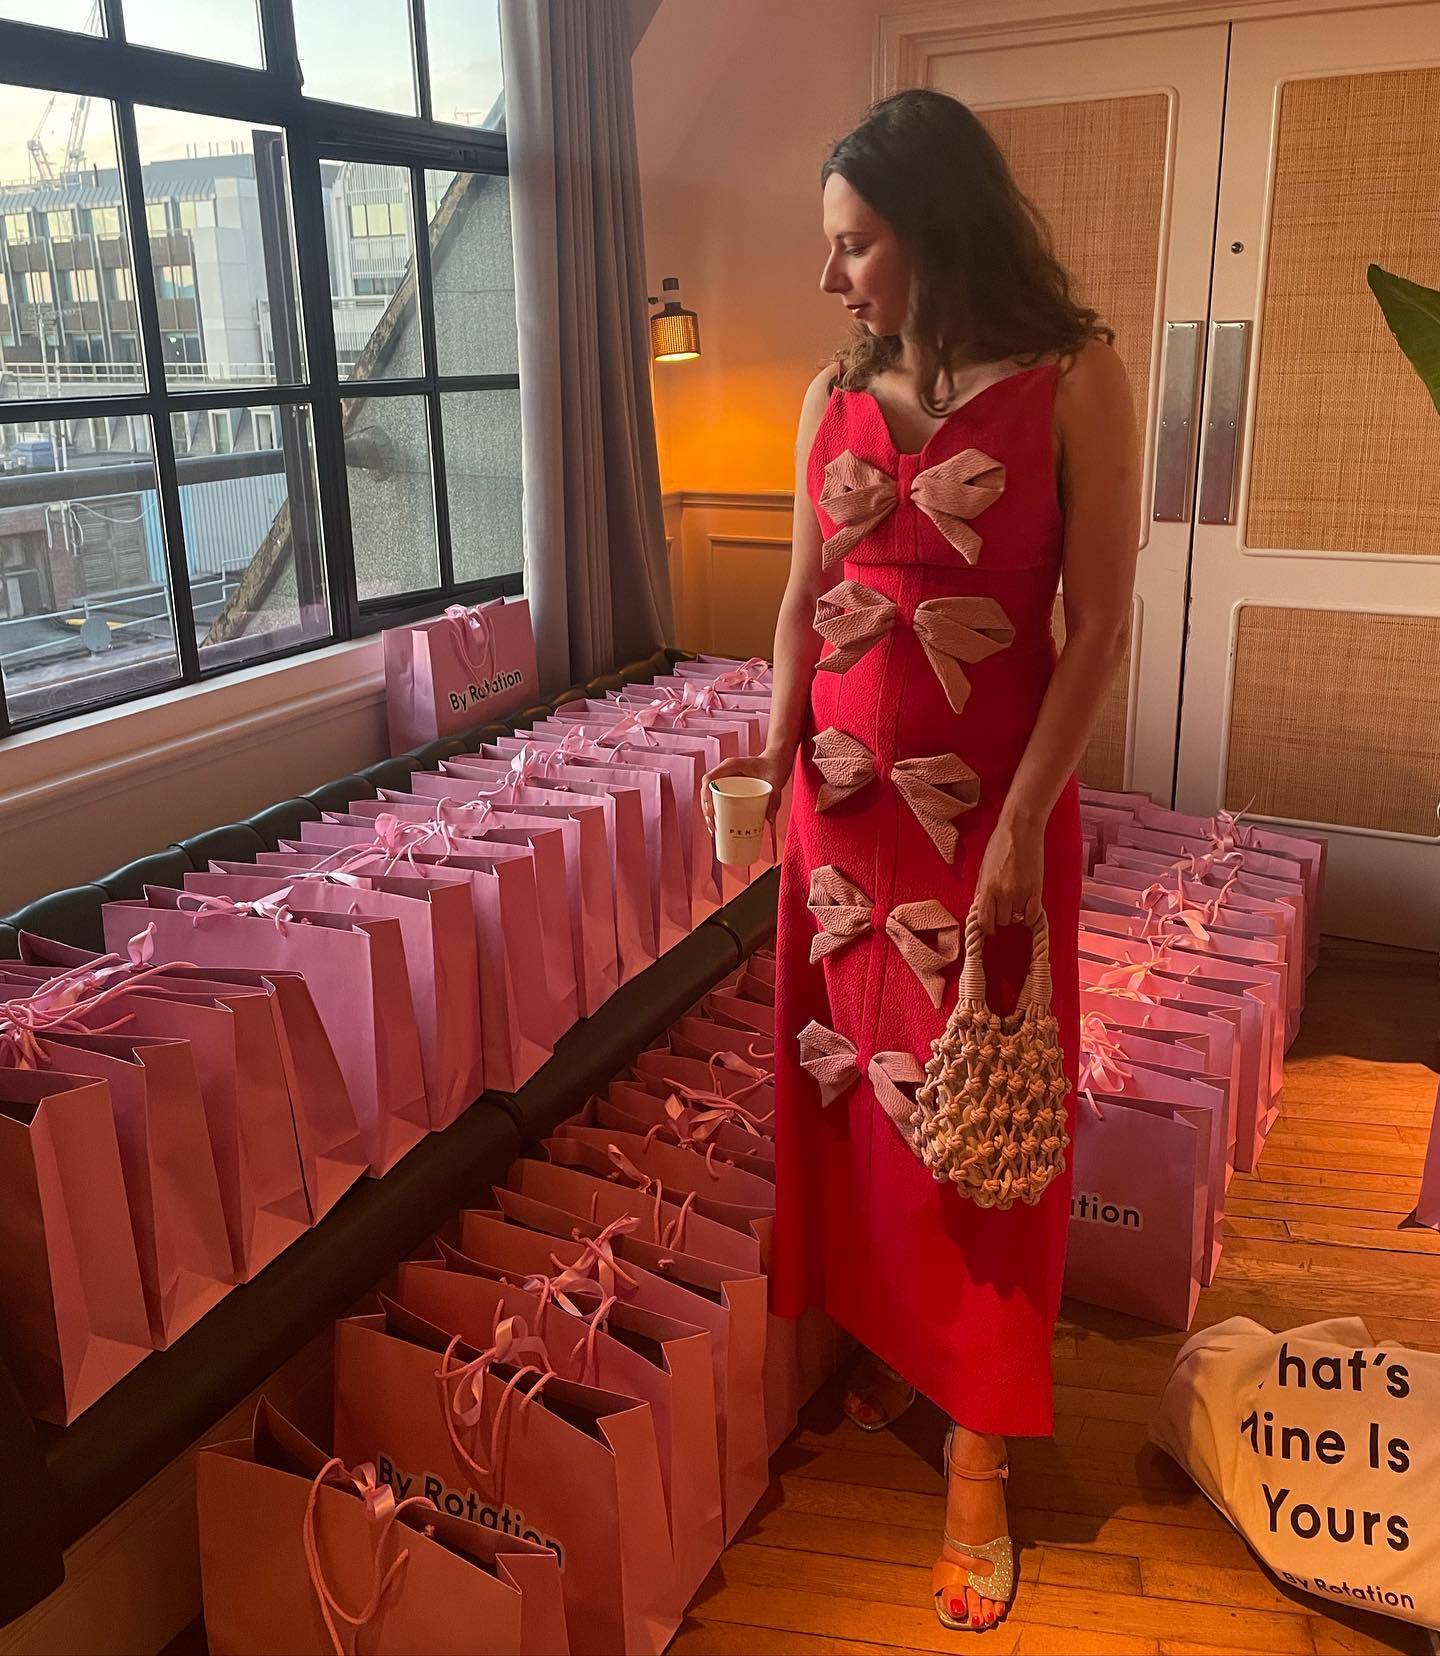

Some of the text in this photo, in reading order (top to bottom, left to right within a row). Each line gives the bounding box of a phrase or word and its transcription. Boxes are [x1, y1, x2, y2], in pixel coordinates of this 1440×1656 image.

[449, 693, 467, 711] By
[1071, 1195, 1140, 1227] tion
[1258, 1343, 1410, 1399] hat's
[1369, 1422, 1411, 1473] Is
[379, 1455, 412, 1500] By
[1261, 1483, 1410, 1552] Yours
[1282, 1571, 1415, 1609] By Rotation
